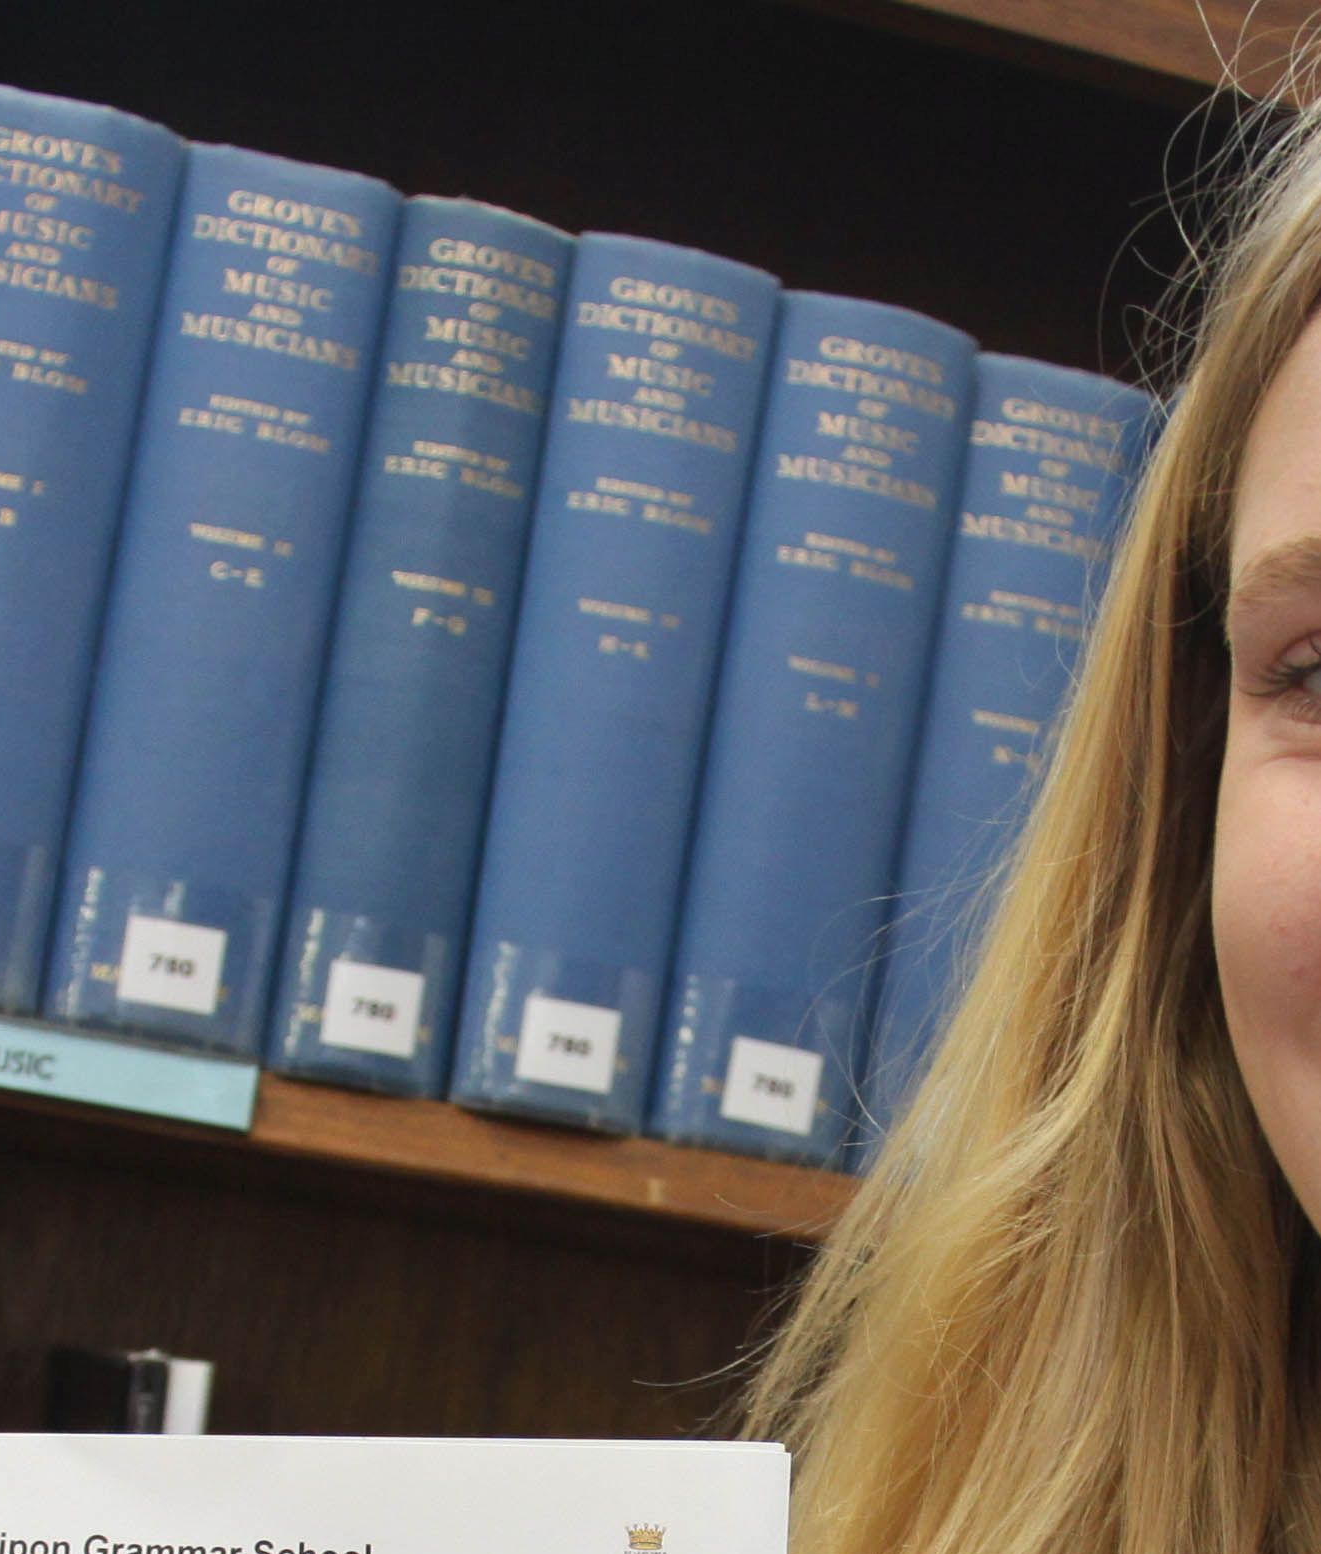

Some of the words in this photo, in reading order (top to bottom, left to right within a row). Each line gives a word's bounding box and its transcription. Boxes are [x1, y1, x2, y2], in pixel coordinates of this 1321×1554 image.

[24, 192, 59, 212] OF
[4, 241, 62, 265] AND
[193, 213, 378, 275] DICTIONARY
[223, 267, 333, 312] MUSIC
[181, 311, 359, 371] MUSICIANS
[149, 953, 196, 977] 780
[351, 996, 397, 1023] 780
[547, 1032, 592, 1058] 780
[753, 1073, 796, 1098] 780
